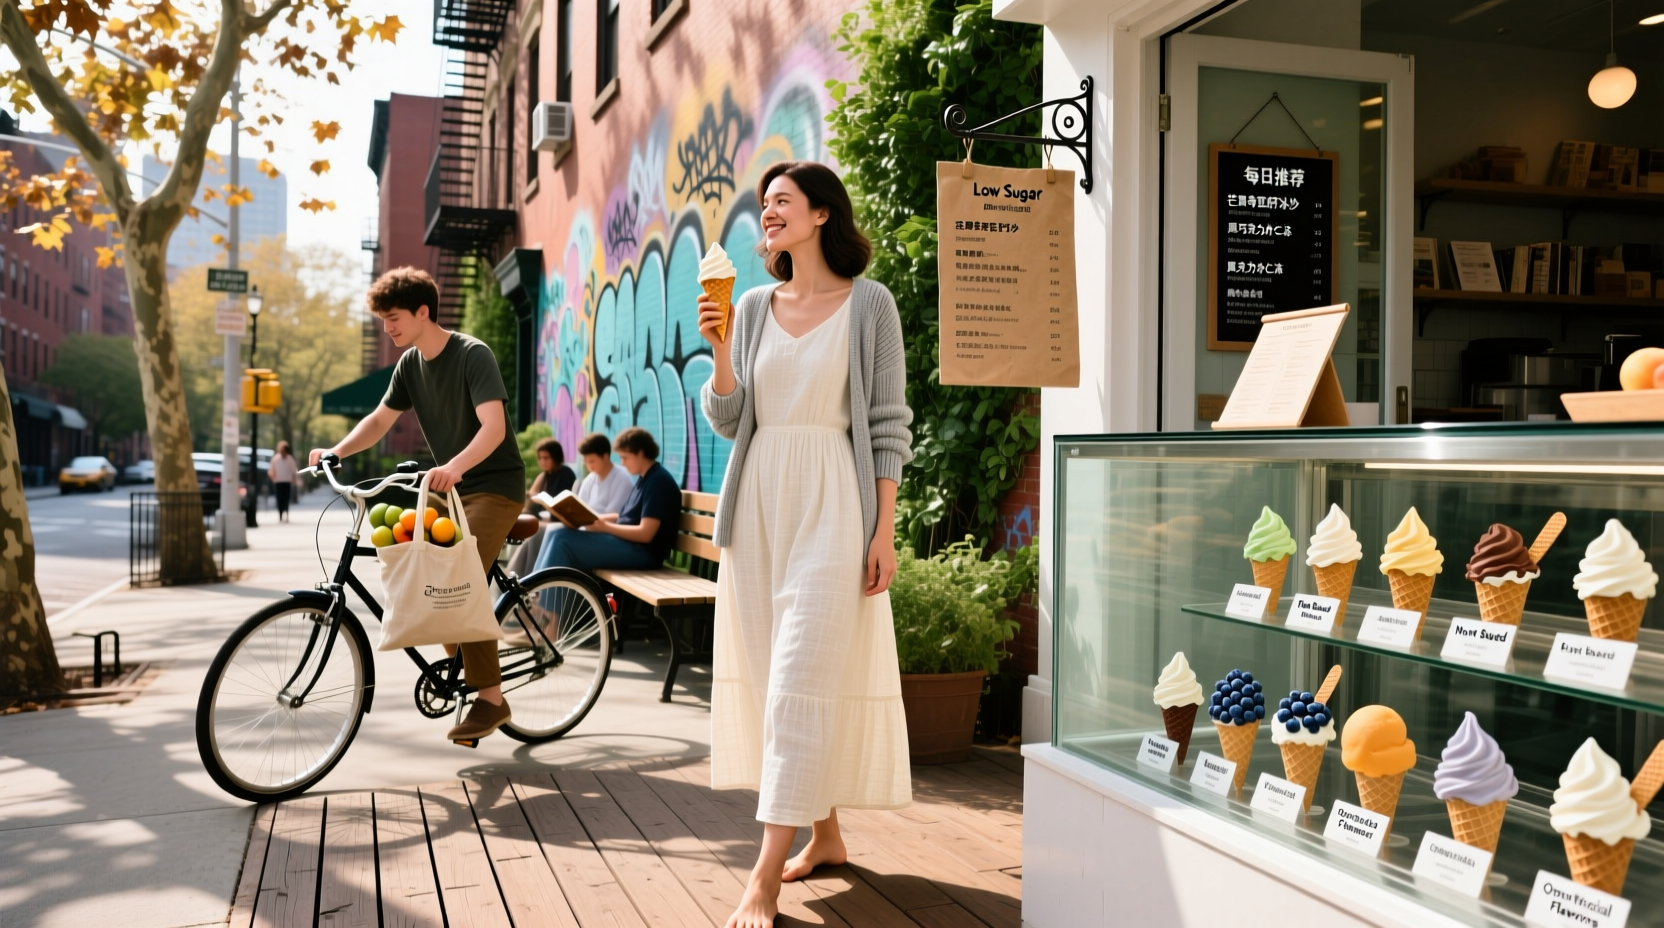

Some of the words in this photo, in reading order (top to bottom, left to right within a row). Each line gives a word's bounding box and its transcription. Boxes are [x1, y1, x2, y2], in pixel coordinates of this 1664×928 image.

[1243, 165, 1306, 188] 每日推荐
[973, 182, 1001, 198] Low
[1003, 184, 1044, 204] Sugar
